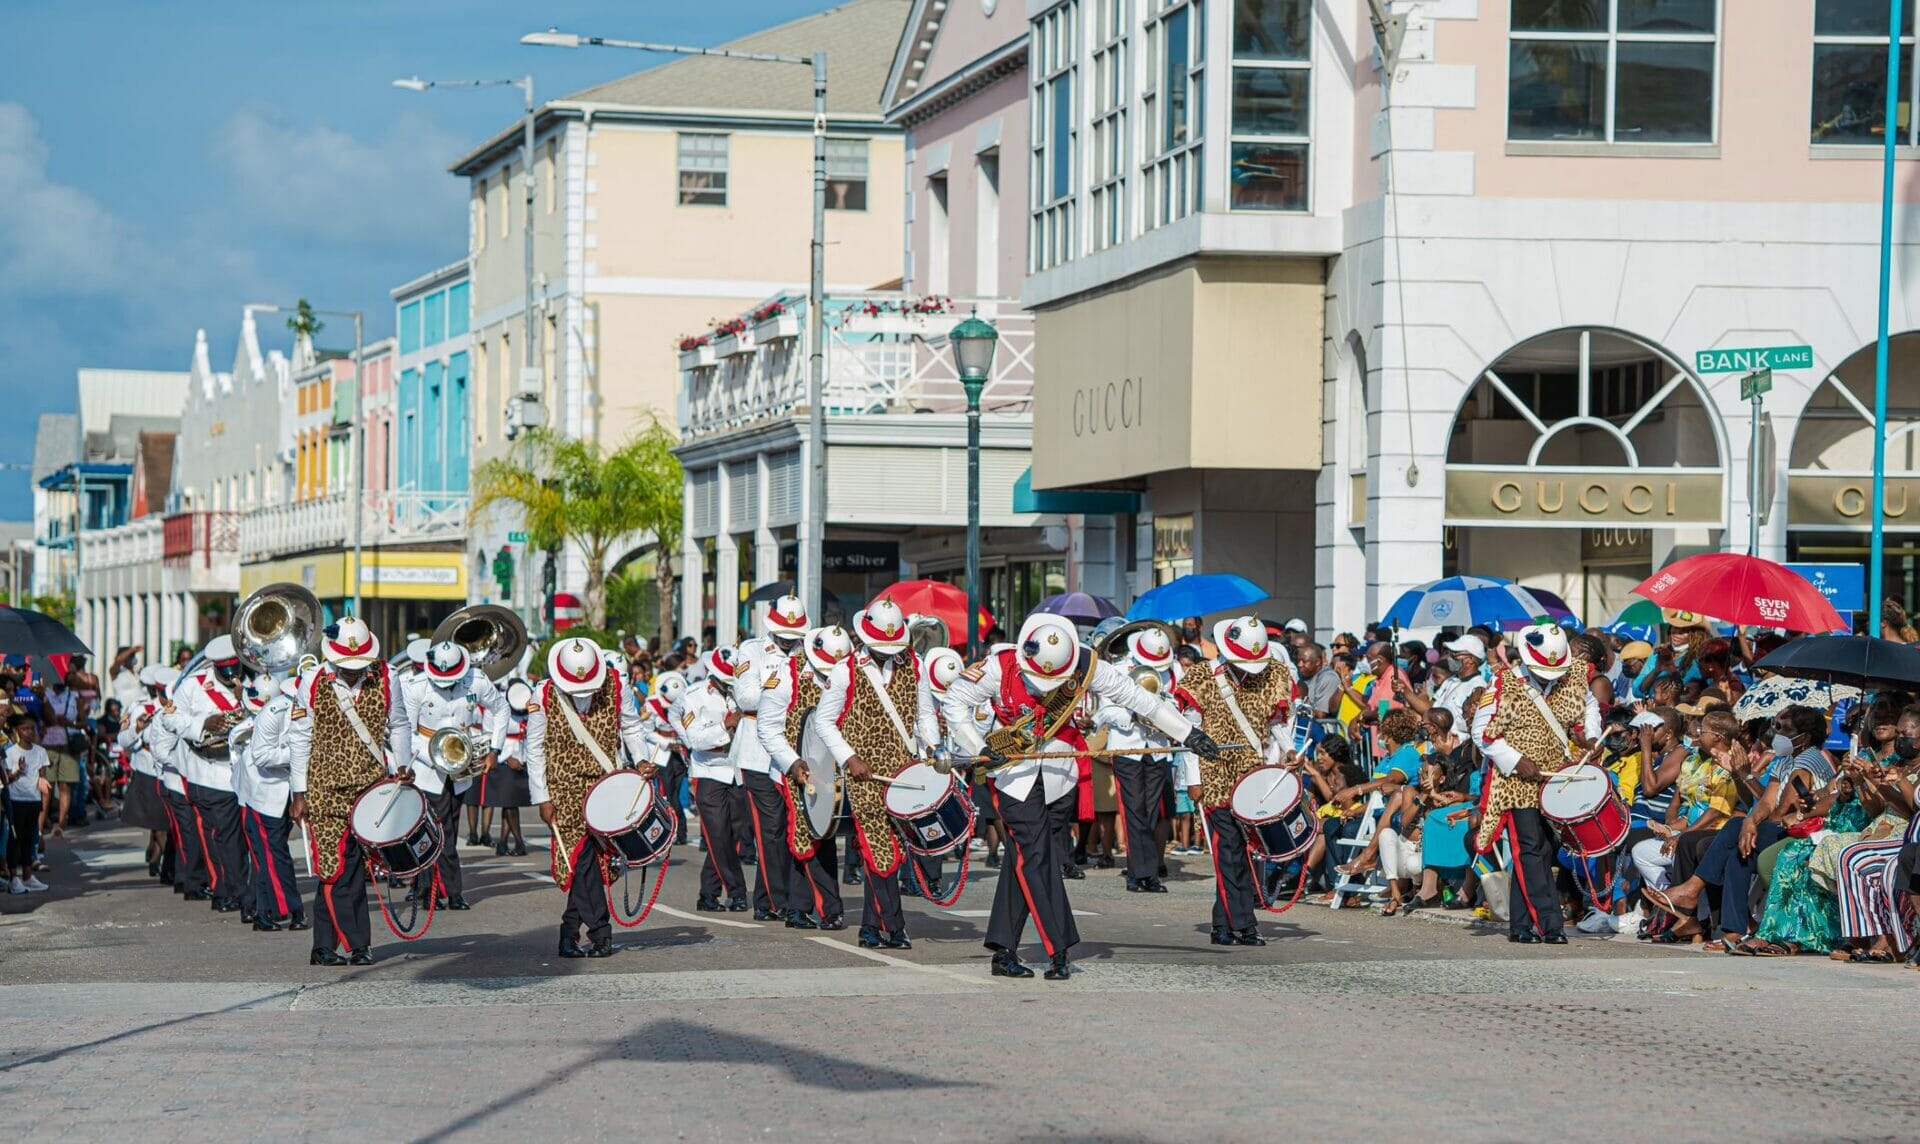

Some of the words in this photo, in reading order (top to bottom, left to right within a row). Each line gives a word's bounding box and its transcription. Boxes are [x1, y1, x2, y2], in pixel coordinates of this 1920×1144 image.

[1700, 351, 1770, 370] BANK
[1775, 352, 1809, 363] LANE
[1073, 377, 1142, 438] GUCCI
[1491, 480, 1676, 515] GUCCI
[1835, 485, 1920, 518] GU
[847, 553, 887, 566] Silver
[1754, 597, 1790, 609] SEVEN
[1760, 607, 1787, 618] SEAS
